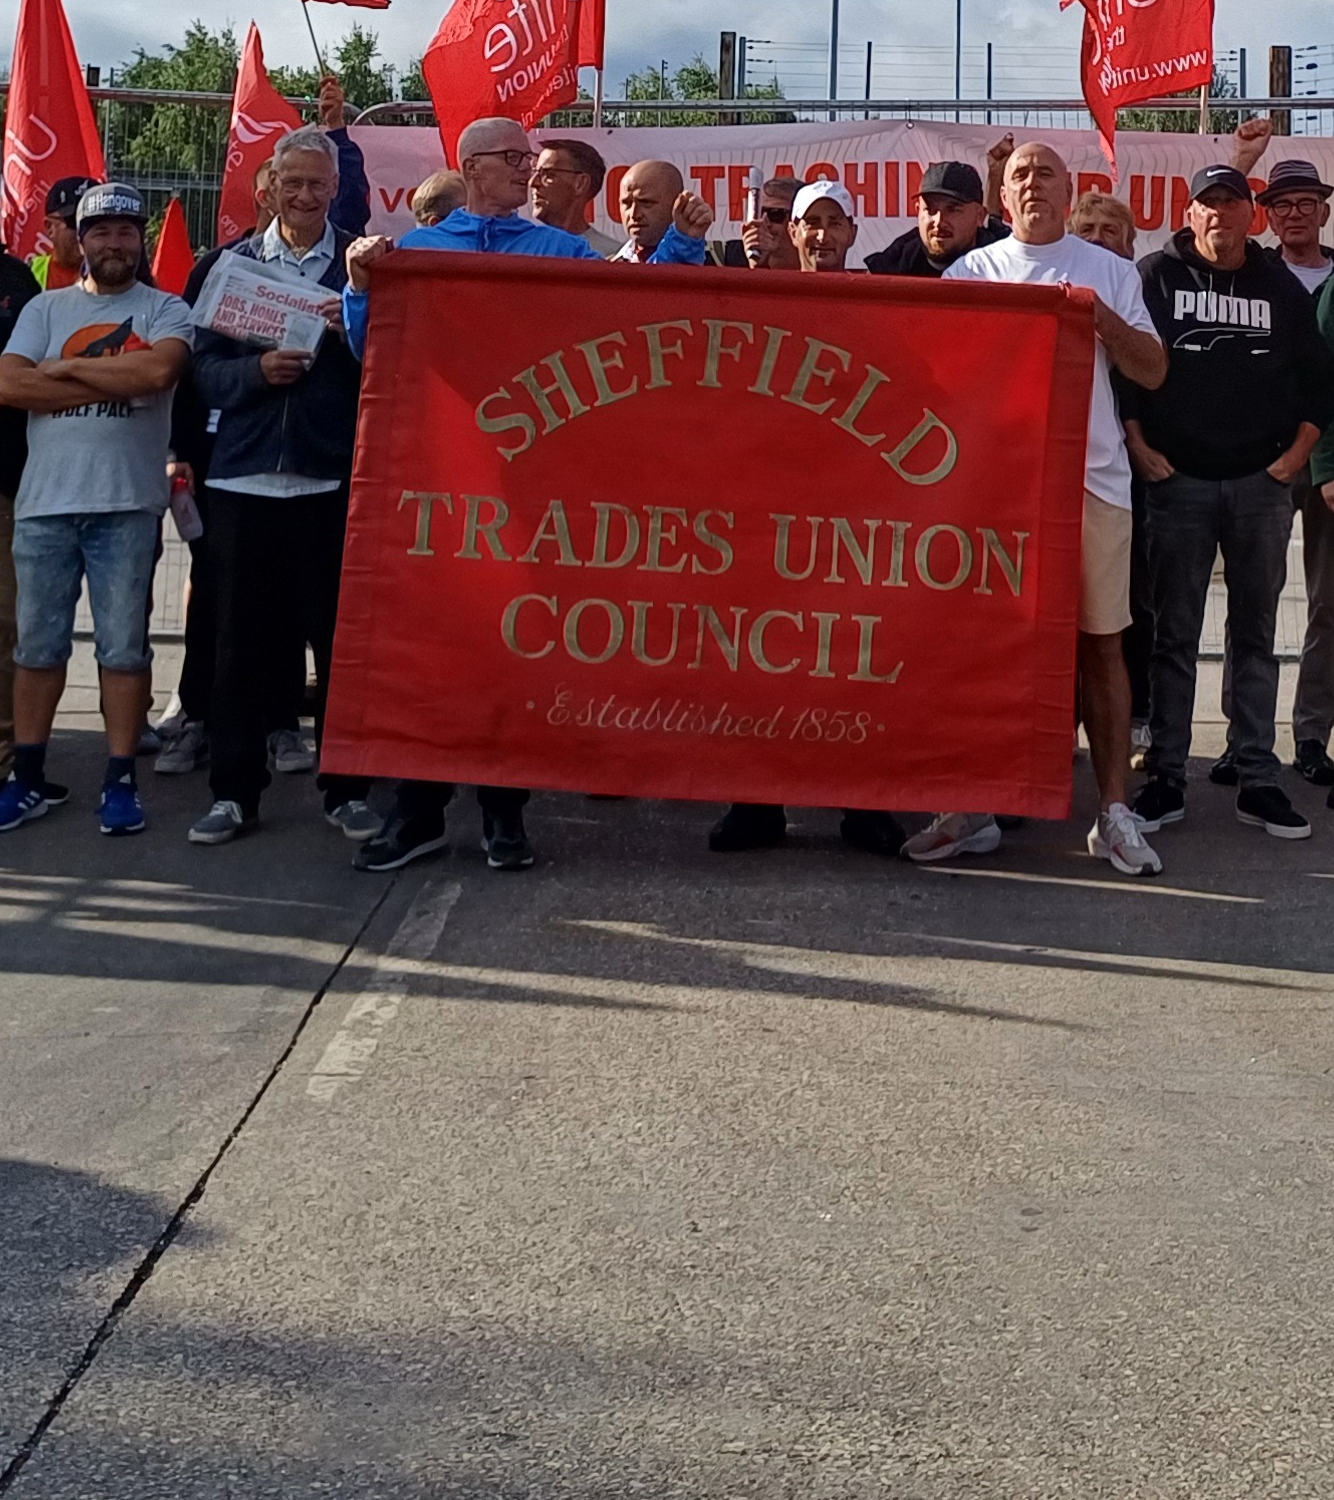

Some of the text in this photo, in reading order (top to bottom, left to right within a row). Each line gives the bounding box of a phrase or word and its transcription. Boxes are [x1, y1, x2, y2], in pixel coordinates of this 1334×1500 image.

[87, 193, 141, 213] #Hangover
[1174, 289, 1271, 330] PUMA
[475, 318, 959, 486] SHEFFIELD
[397, 489, 1031, 598] TRADES UNION
[501, 593, 905, 685] COUNCIL
[546, 681, 872, 744] Established 1858
